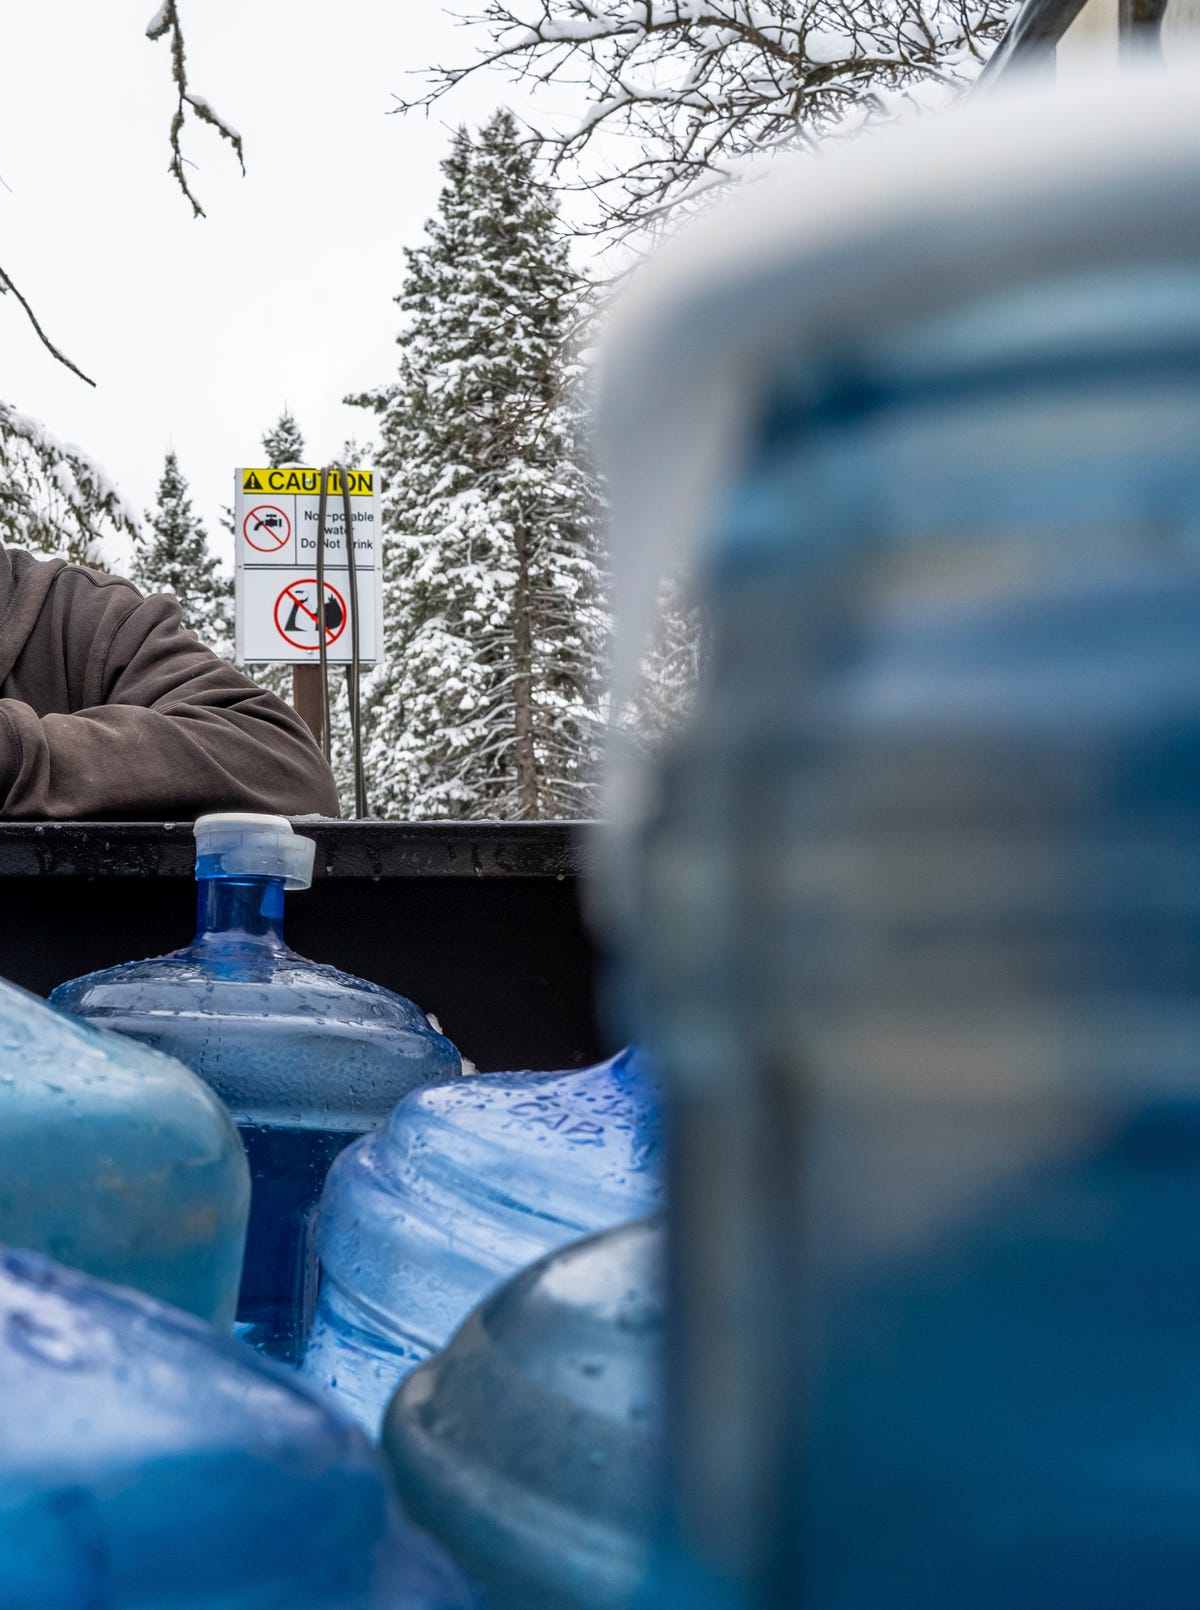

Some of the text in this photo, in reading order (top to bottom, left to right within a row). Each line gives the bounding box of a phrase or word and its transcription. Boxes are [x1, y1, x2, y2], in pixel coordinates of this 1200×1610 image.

[304, 510, 374, 523] No-poable
[301, 538, 316, 548] Do
[351, 539, 373, 549] rink
